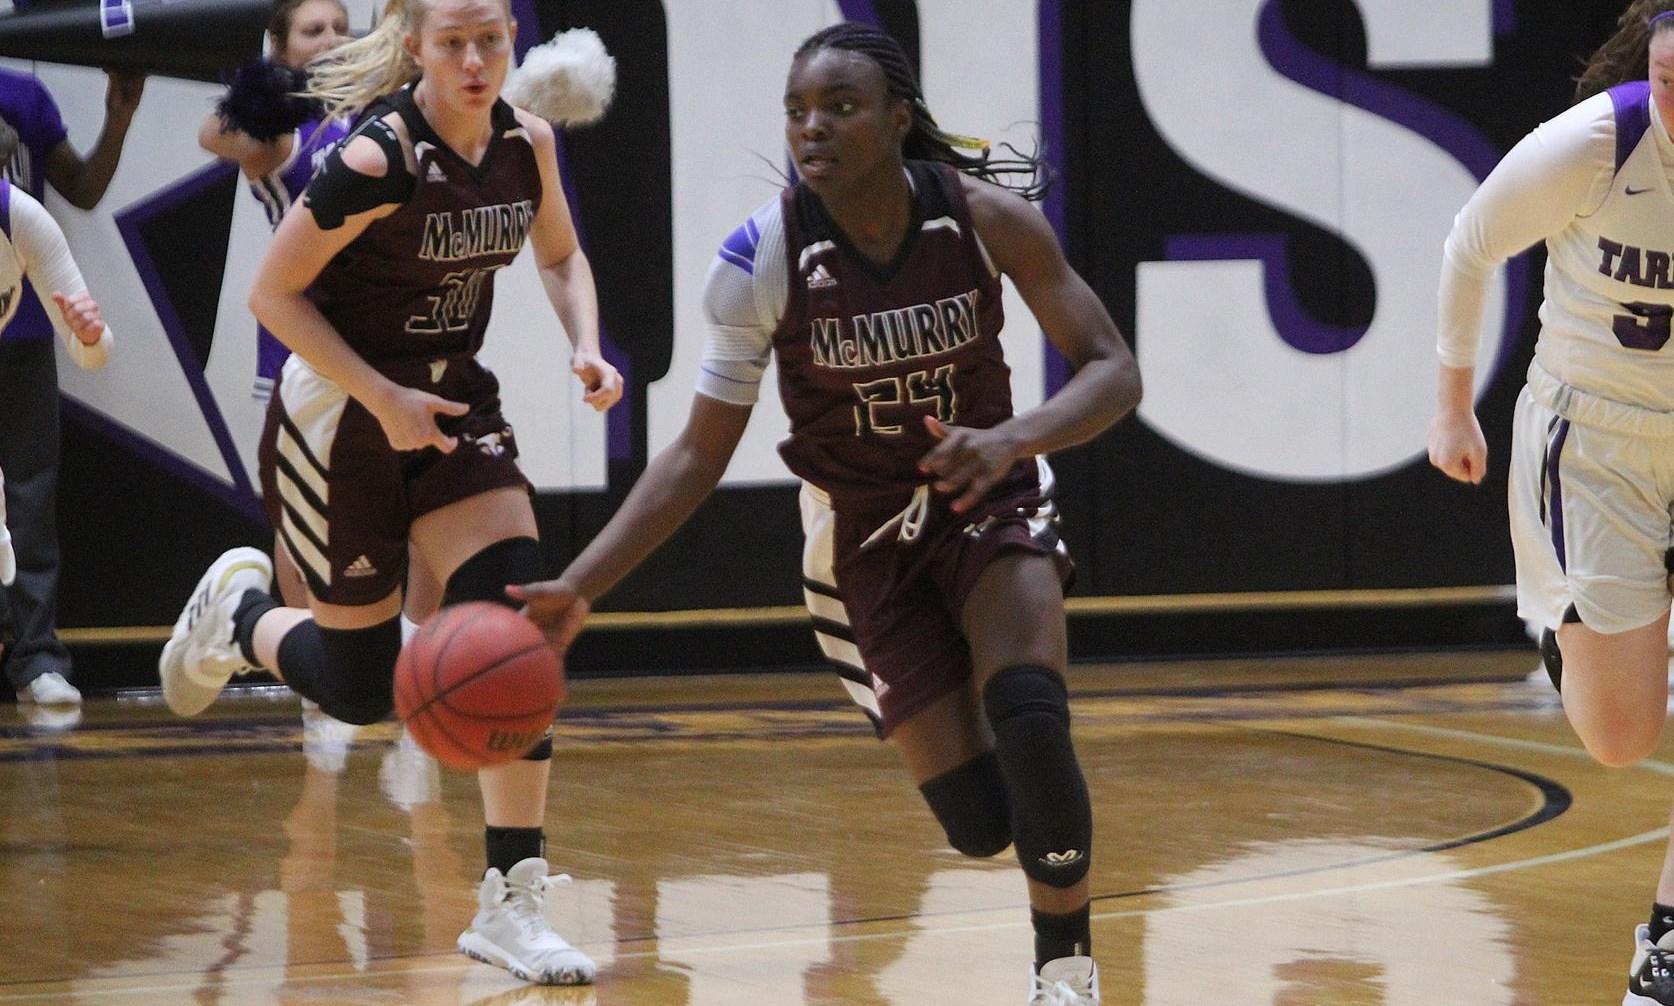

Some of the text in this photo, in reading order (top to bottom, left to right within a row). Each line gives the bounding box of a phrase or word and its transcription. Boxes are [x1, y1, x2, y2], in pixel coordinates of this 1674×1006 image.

[1598, 235, 1674, 289] TAR
[811, 289, 978, 368] McMURRY
[852, 363, 957, 437] 24
